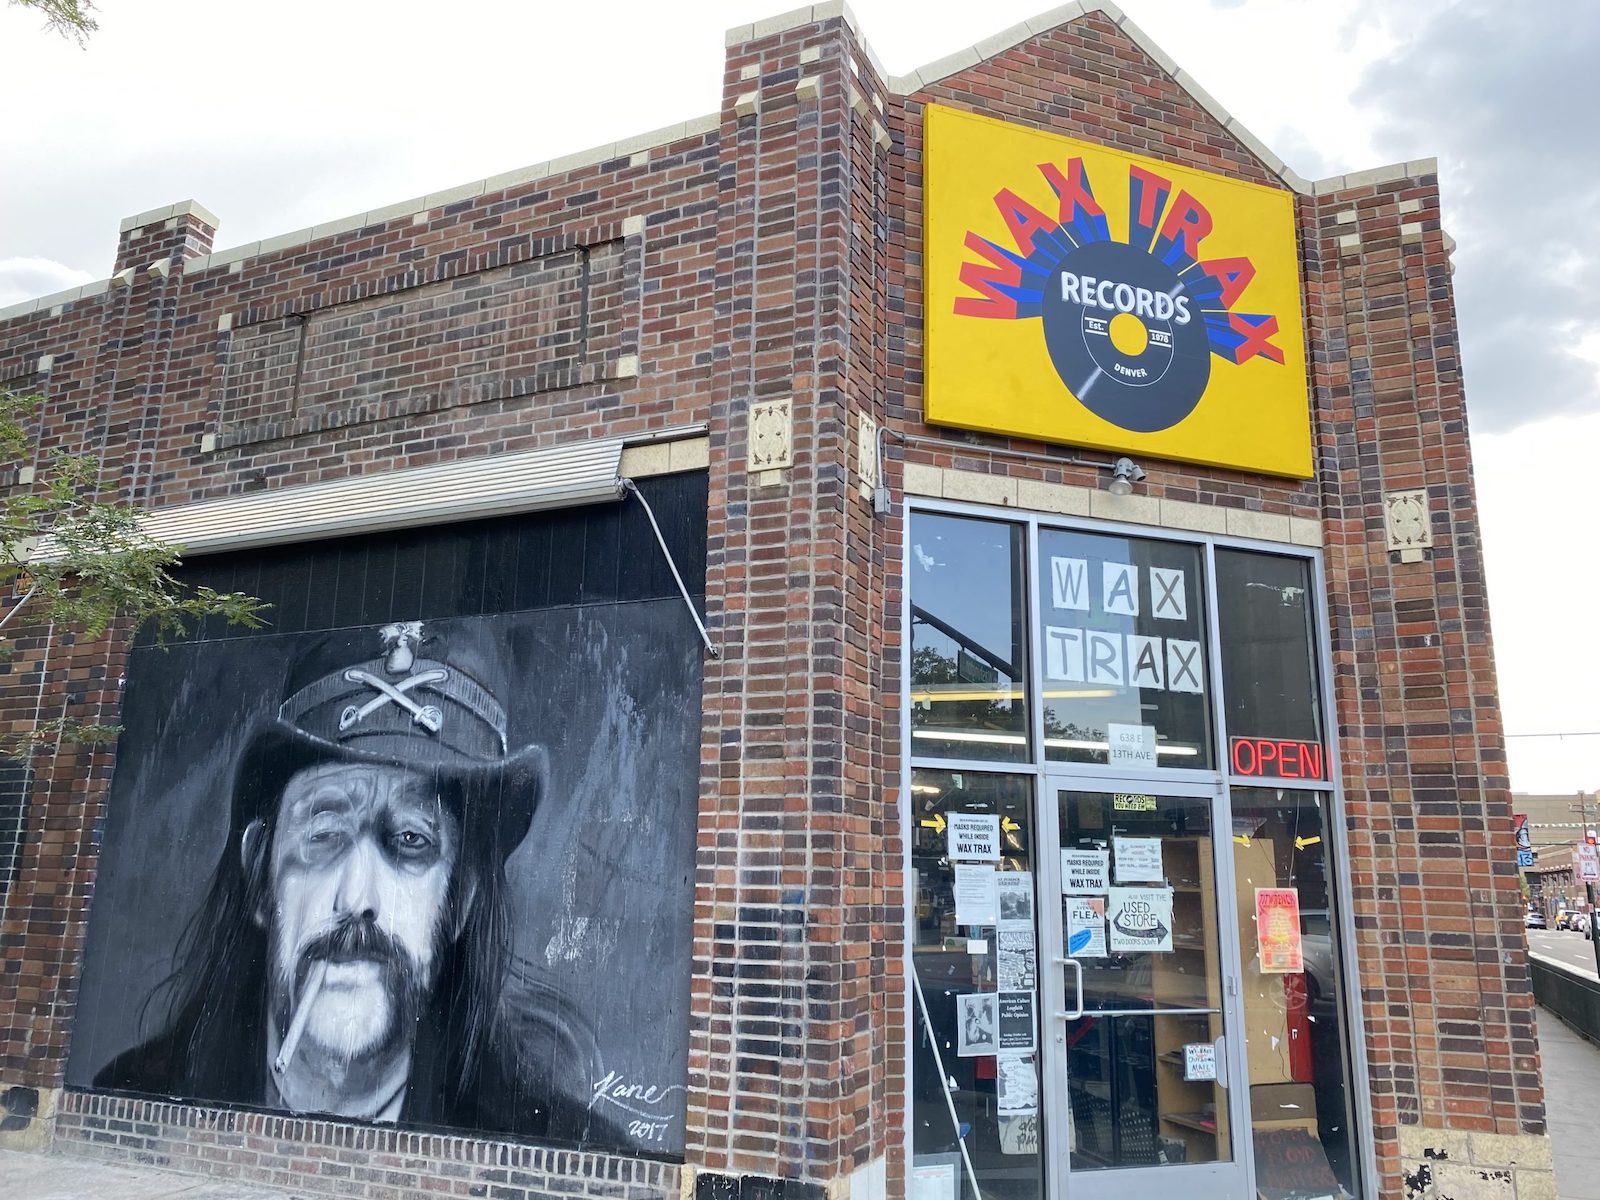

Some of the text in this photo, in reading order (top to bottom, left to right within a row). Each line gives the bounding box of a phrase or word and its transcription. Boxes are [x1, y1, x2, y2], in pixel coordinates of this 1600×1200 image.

[953, 157, 1285, 366] WAX TRAX
[1061, 271, 1191, 325] RECORDS
[1088, 320, 1105, 331] Est.
[1151, 333, 1169, 343] 1978
[1114, 363, 1148, 378] DENVER
[1055, 561, 1182, 615] WAX
[1050, 631, 1199, 688] TRAX
[1120, 733, 1145, 744] 638 E.
[1113, 749, 1154, 760] 13TH AVE.
[1233, 739, 1321, 778] OPEN
[954, 823, 969, 831] MASKS
[974, 833, 989, 841] INSIDE
[957, 843, 991, 854] WAX TRAX
[1082, 859, 1104, 867] REQUIRED
[1070, 878, 1103, 888] WAX TRAX
[1123, 901, 1151, 914] USED
[1072, 910, 1099, 919] FLEA
[1123, 914, 1157, 927] STORE
[587, 1070, 680, 1110] Kane
[629, 1120, 668, 1141] 2017
